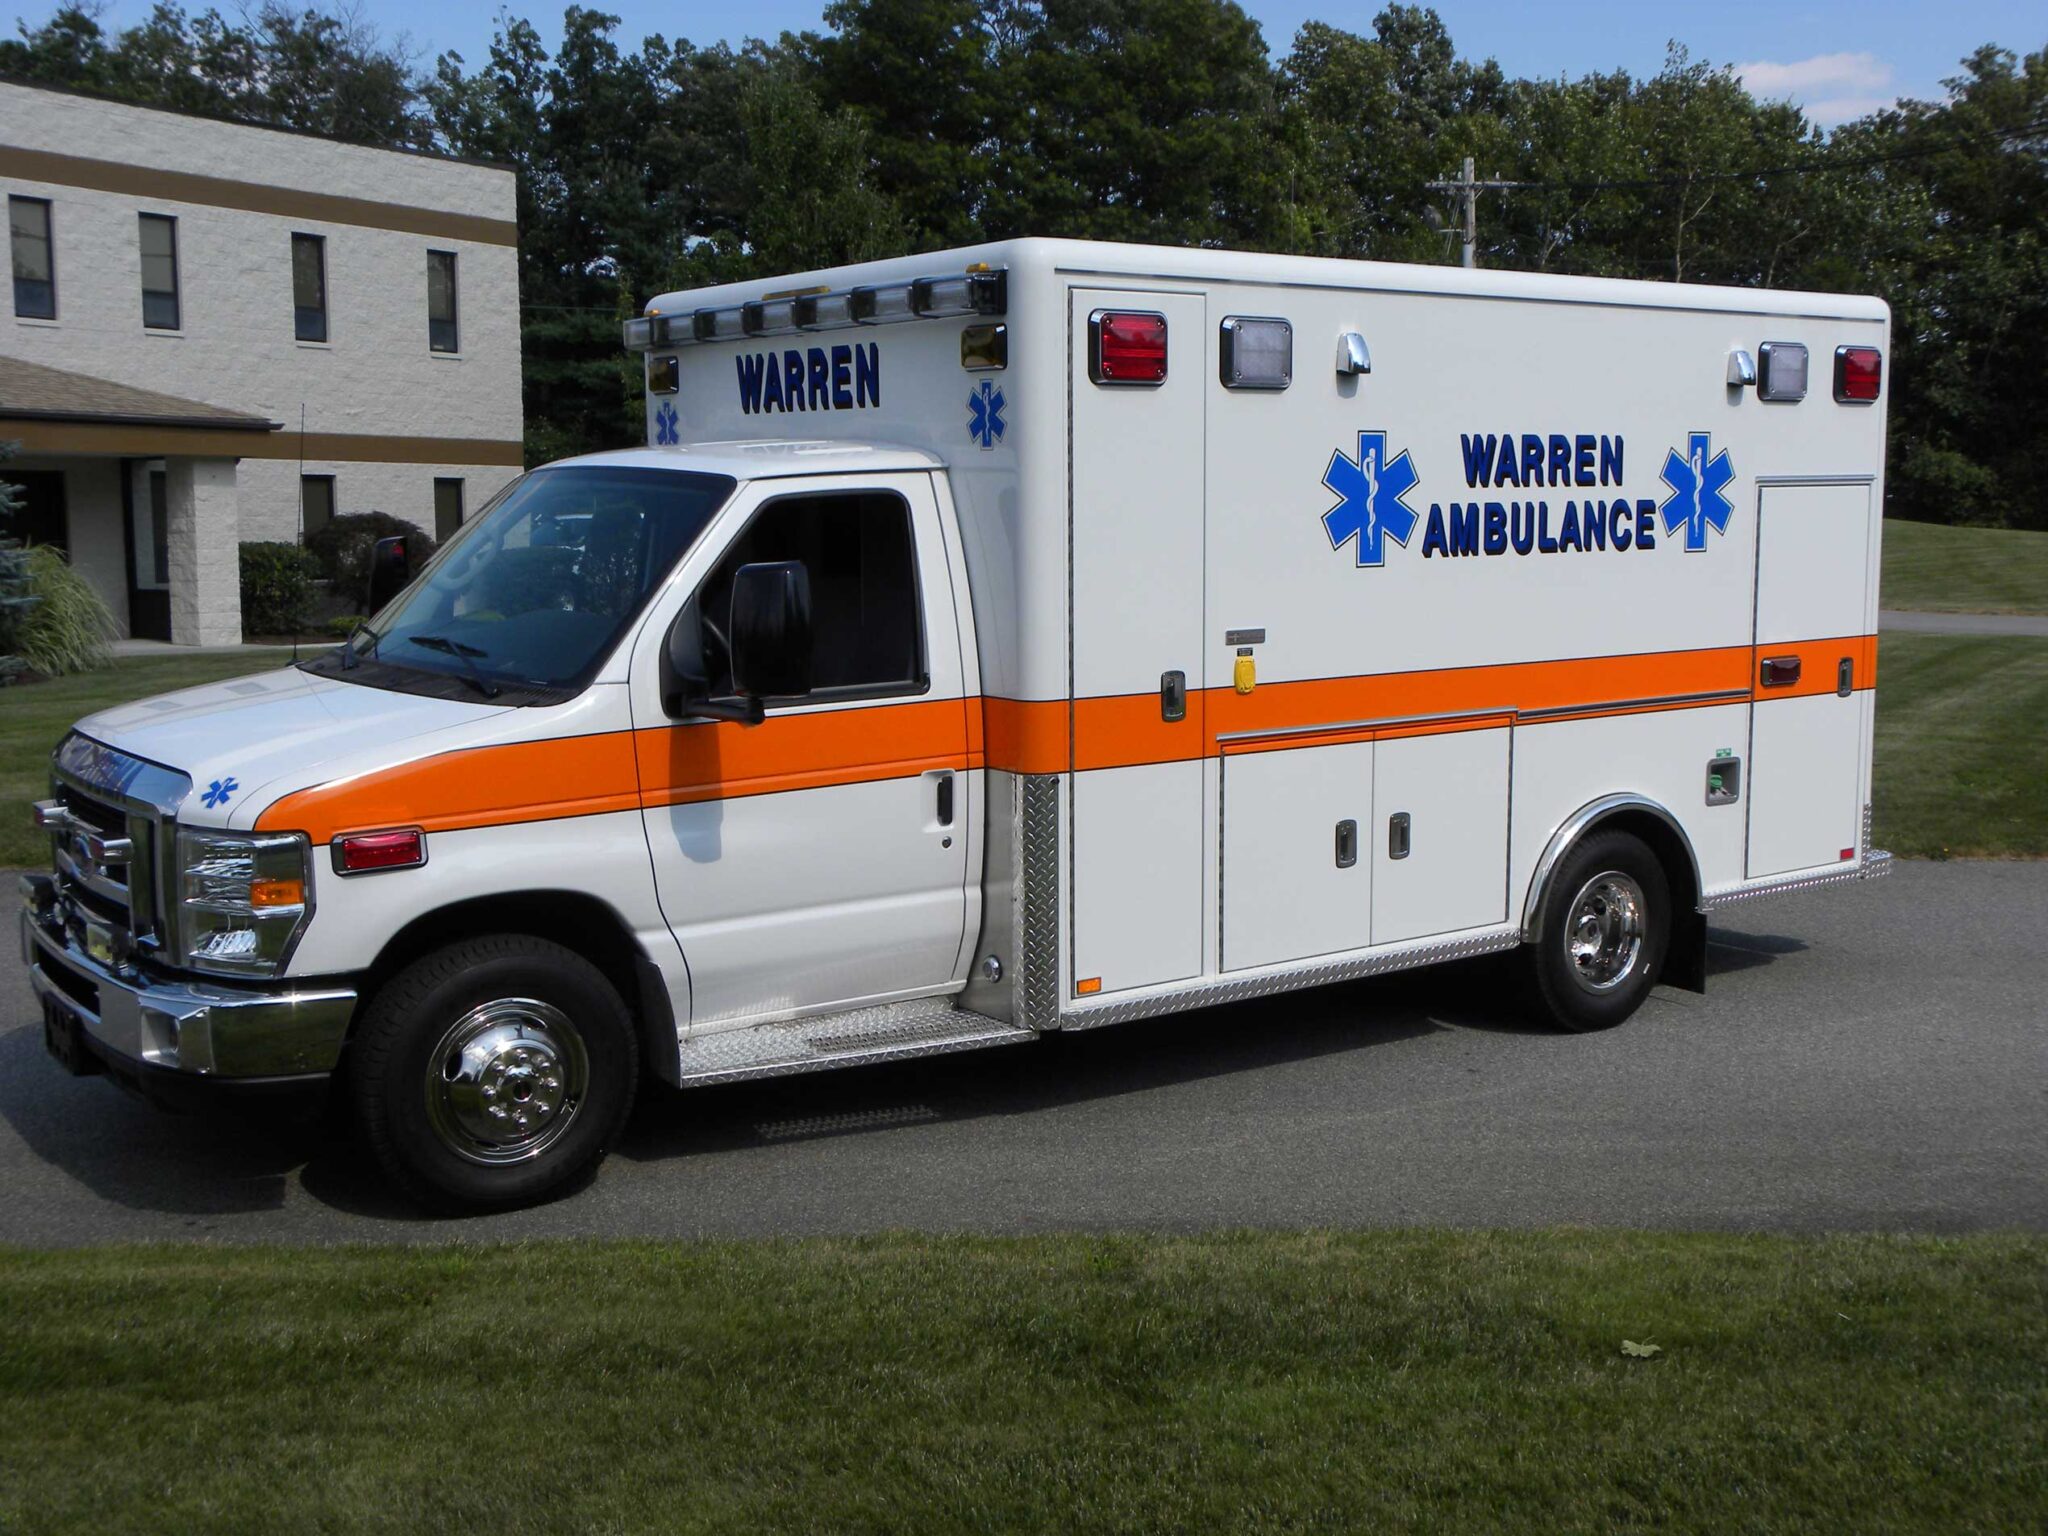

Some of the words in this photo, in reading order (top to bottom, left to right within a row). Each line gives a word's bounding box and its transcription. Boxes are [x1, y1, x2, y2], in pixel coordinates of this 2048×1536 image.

[736, 342, 880, 414] WARREN
[1460, 434, 1624, 488] WARREN
[1421, 498, 1656, 558] AMBULANCE
